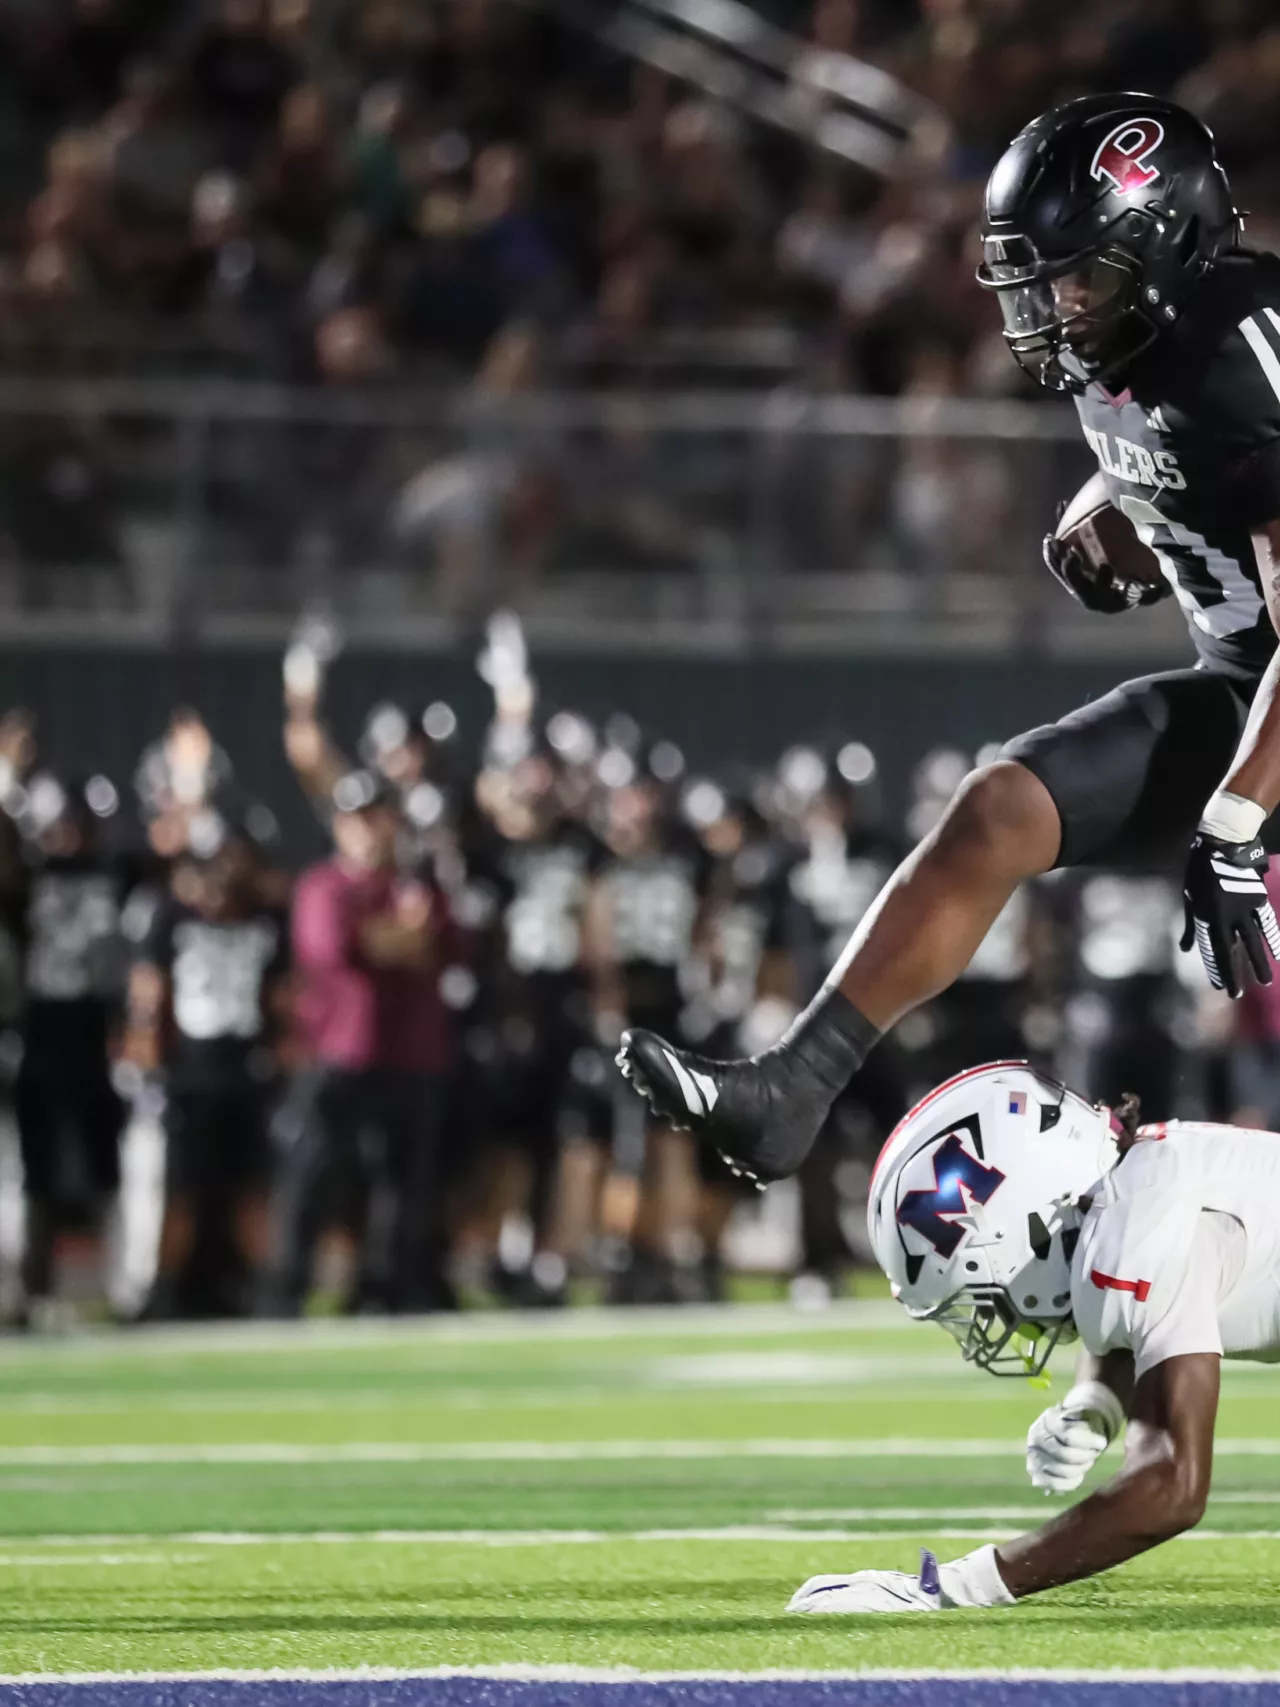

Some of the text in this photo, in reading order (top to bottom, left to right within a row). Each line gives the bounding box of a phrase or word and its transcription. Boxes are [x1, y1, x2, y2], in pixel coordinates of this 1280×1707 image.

[1090, 117, 1165, 198] P
[1082, 424, 1188, 490] ILERS
[896, 1132, 1007, 1260] M
[1090, 1269, 1152, 1303] 1
